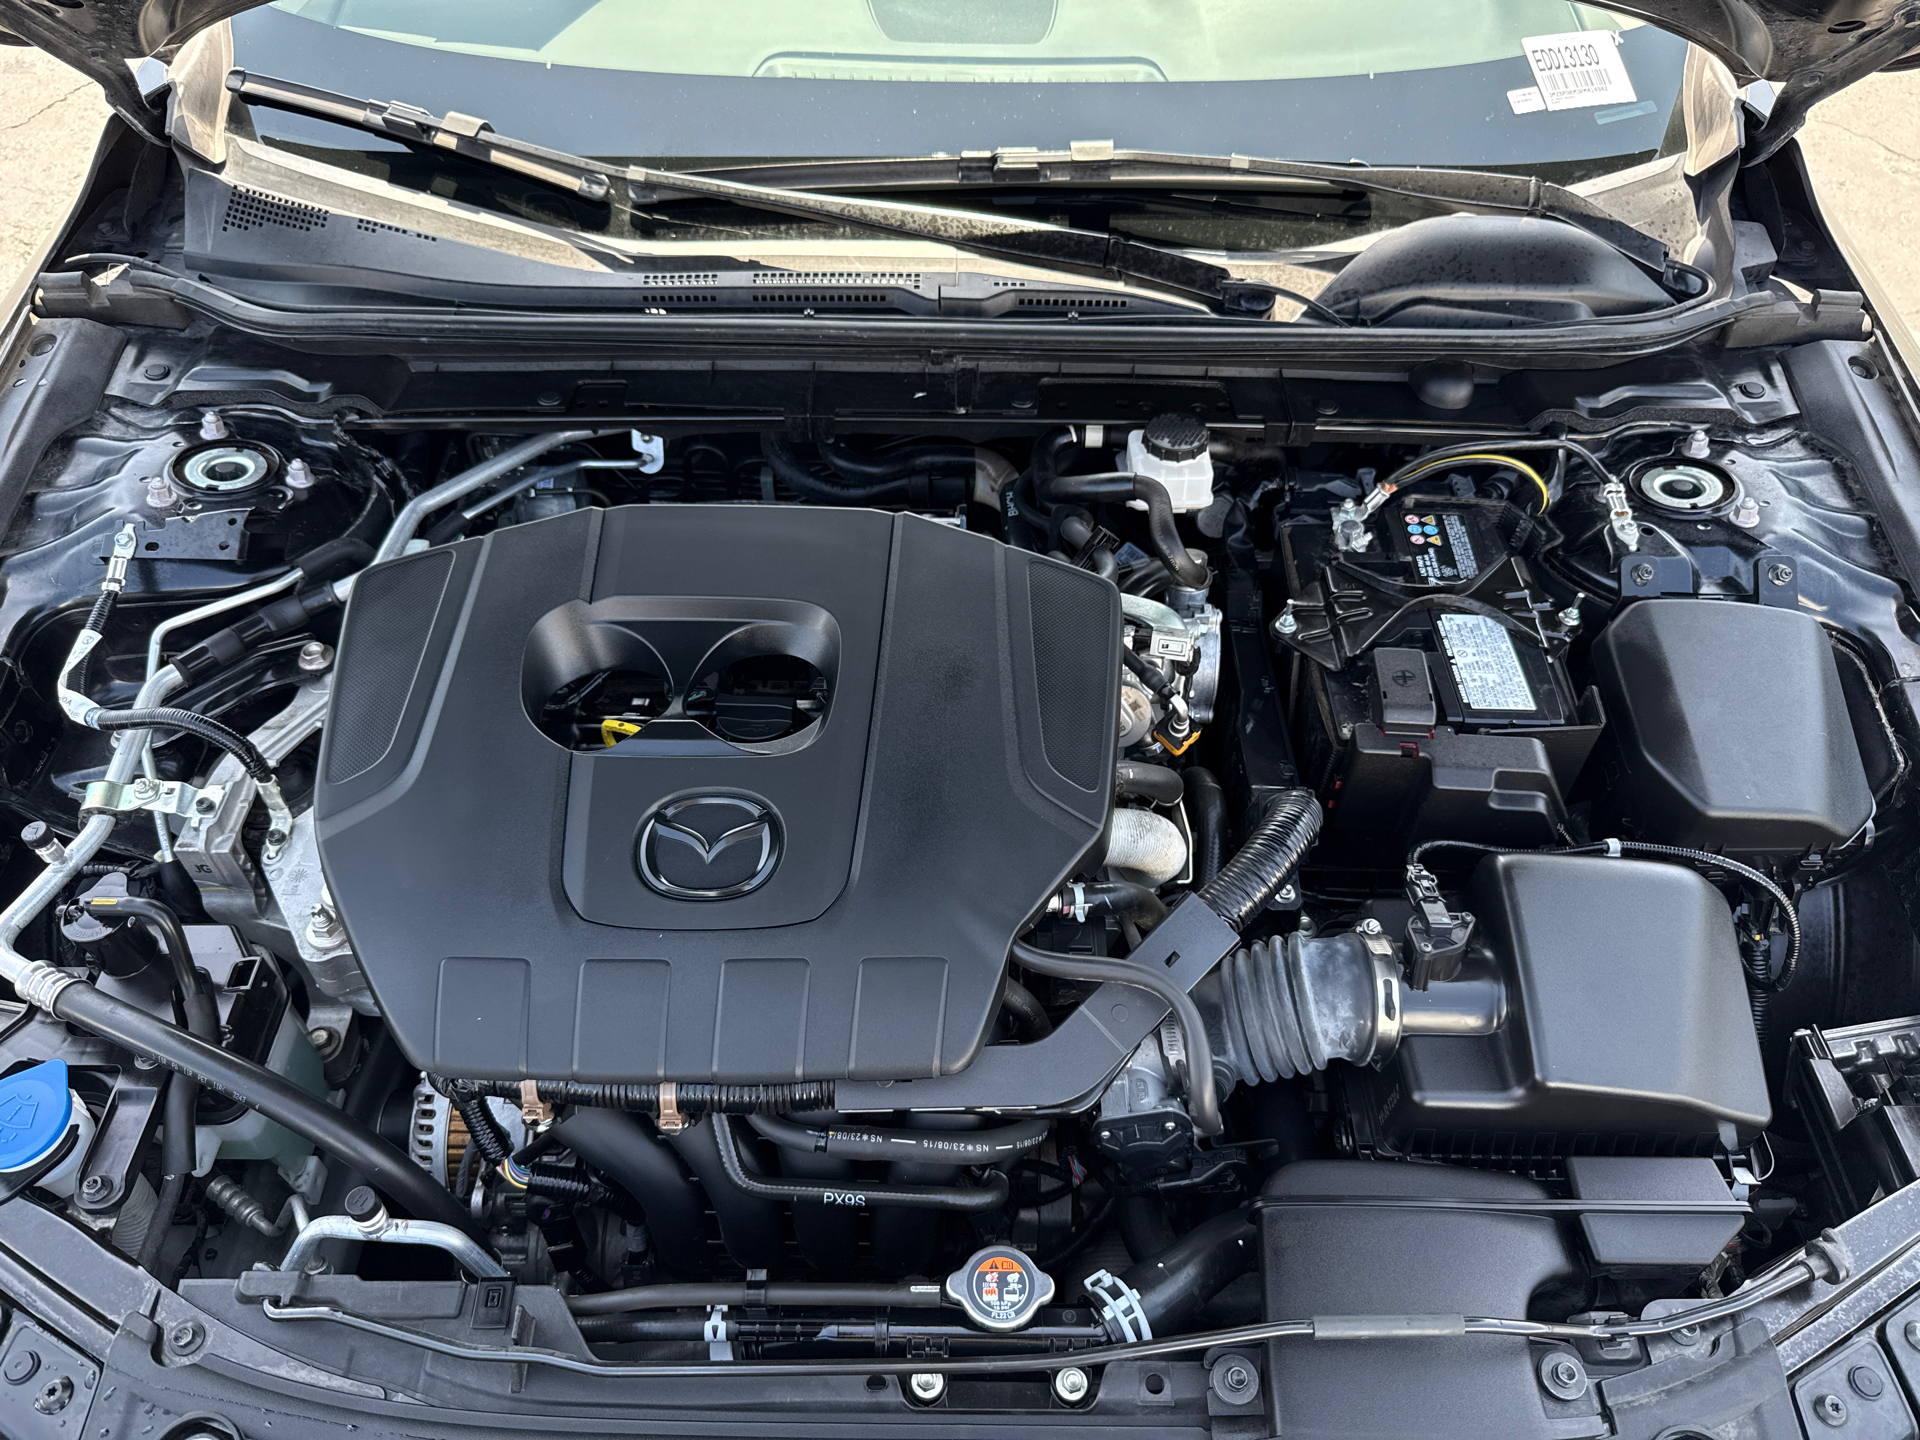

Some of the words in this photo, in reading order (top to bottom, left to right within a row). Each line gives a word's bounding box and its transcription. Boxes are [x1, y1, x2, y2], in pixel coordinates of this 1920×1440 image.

[1531, 44, 1600, 72] EDD13130
[194, 863, 213, 873] JG
[197, 1074, 208, 1084] PET
[823, 1192, 866, 1207] PX9S
